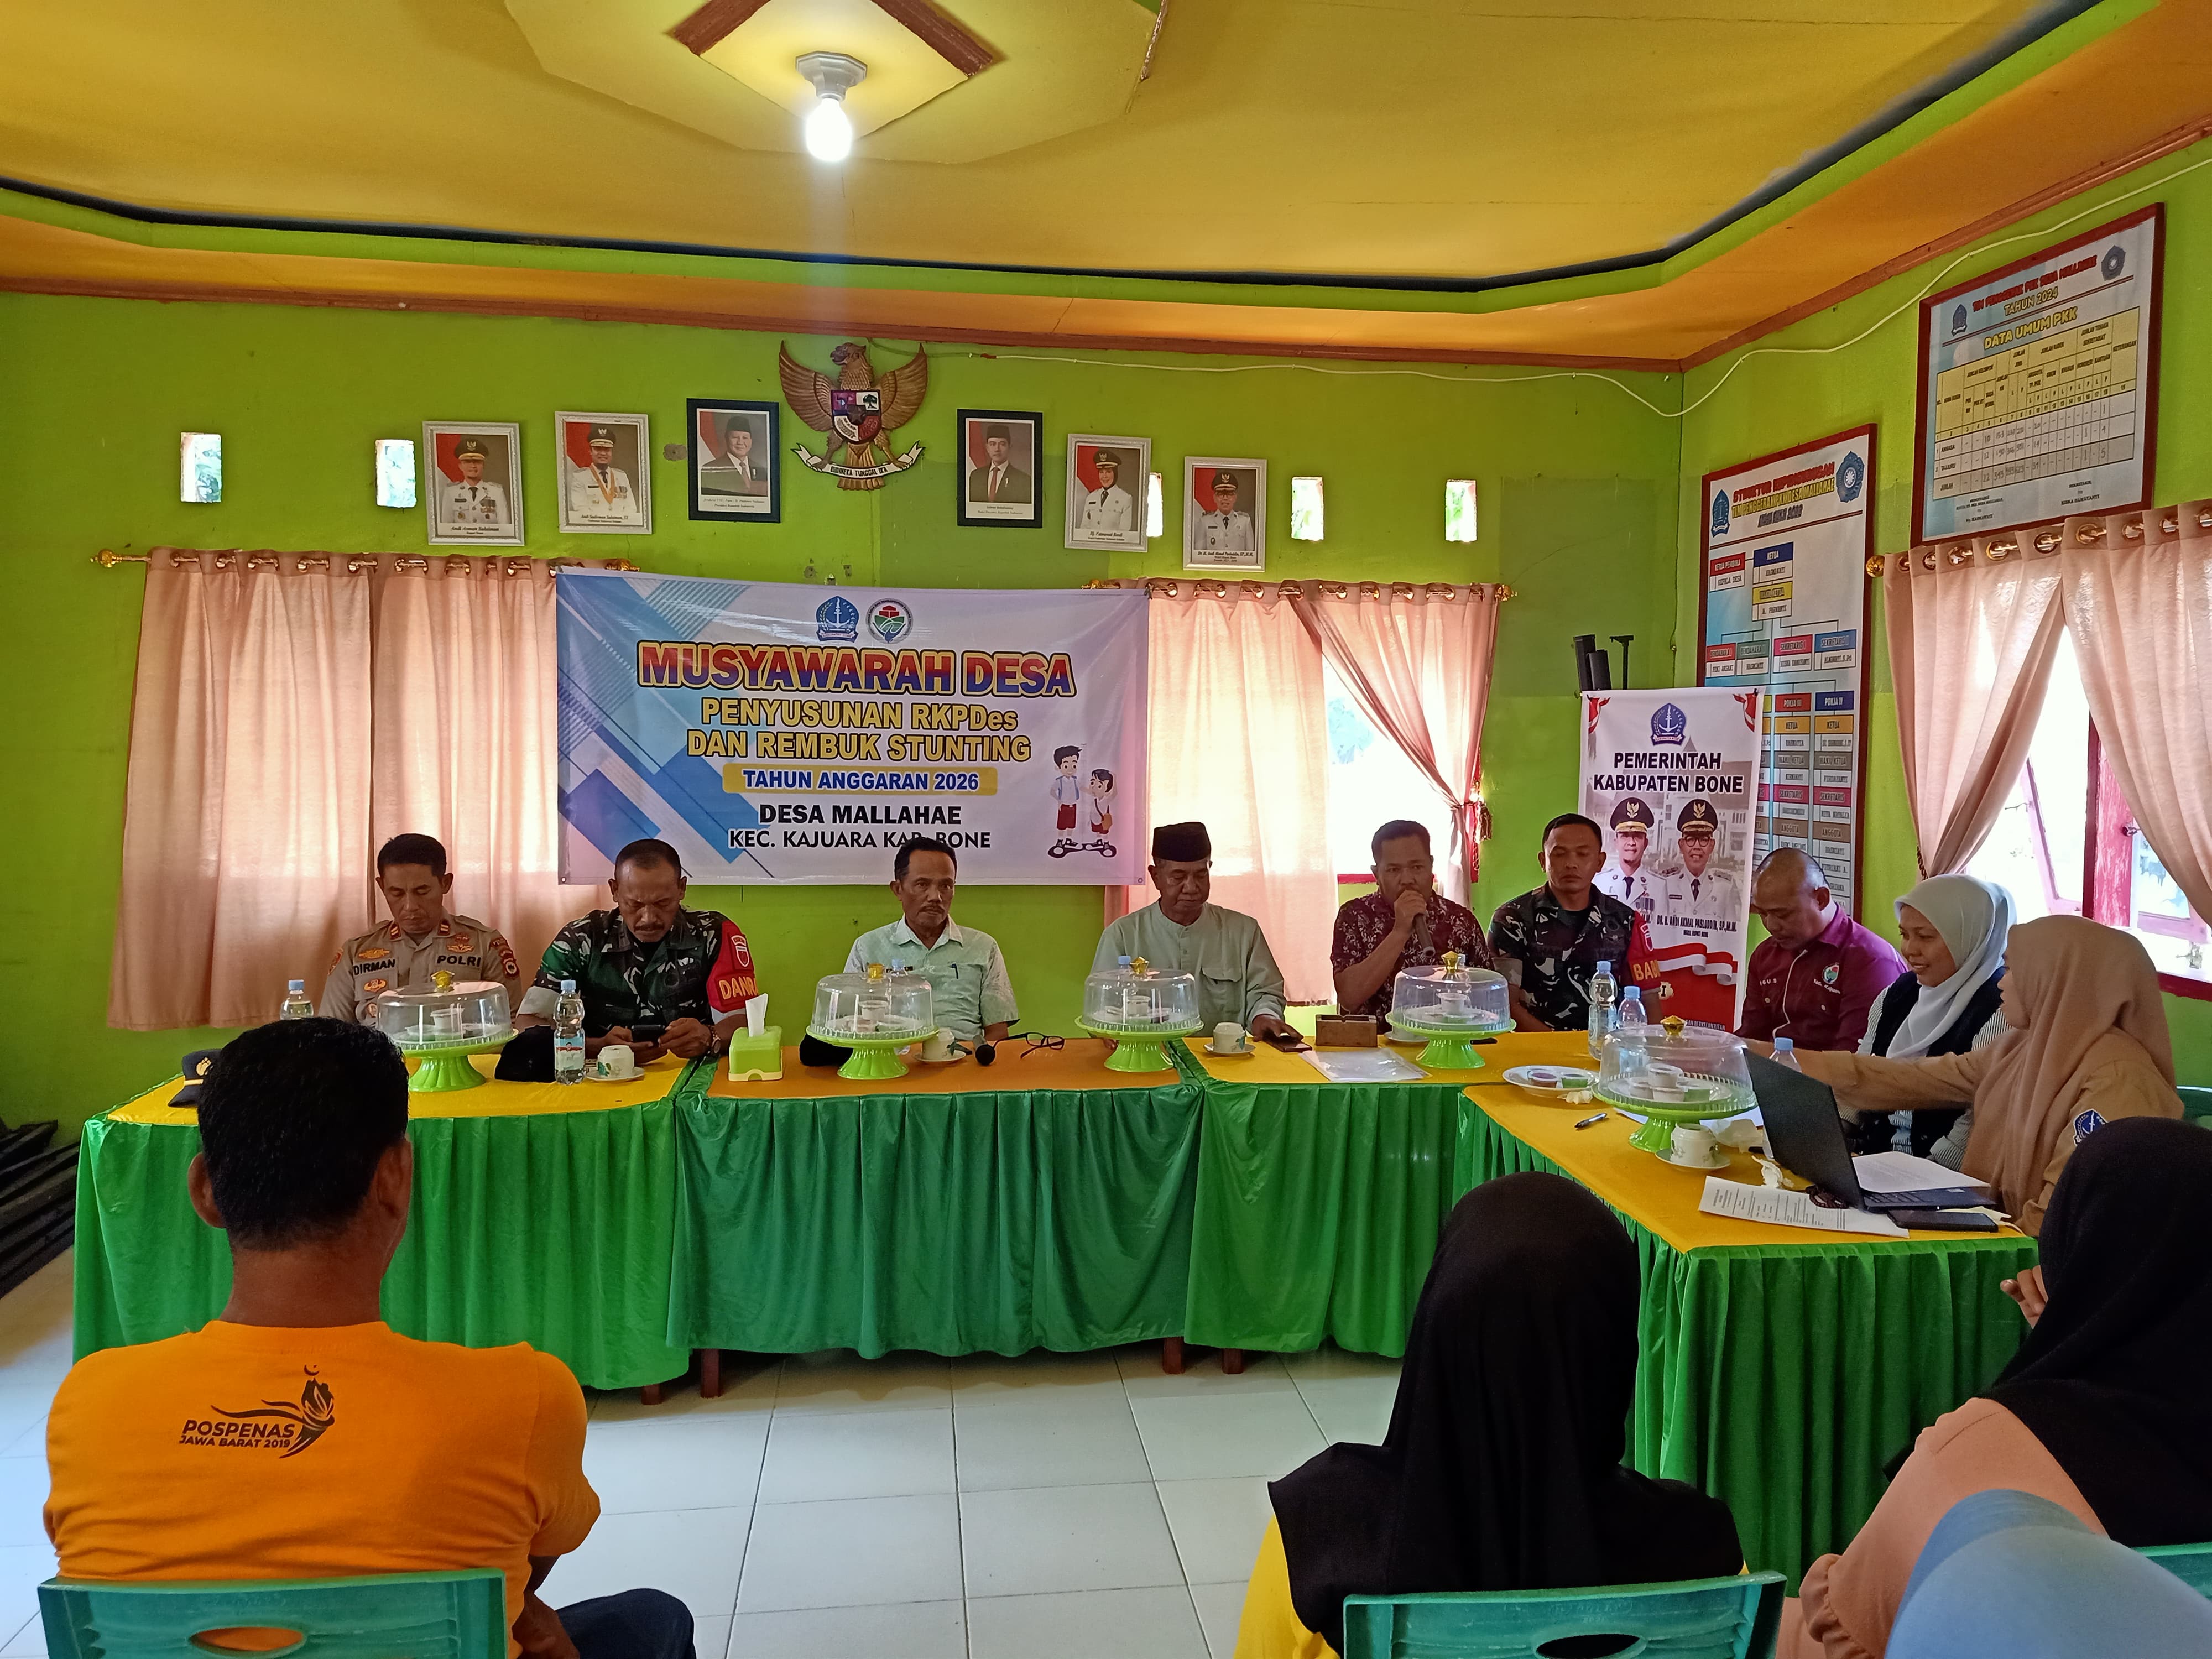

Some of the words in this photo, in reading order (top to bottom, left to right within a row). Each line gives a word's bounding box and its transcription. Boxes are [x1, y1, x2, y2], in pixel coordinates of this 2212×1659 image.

[2004, 295, 2035, 316] TAHUN
[2037, 286, 2059, 304] 2024
[1984, 330, 2013, 350] DATA
[2015, 316, 2051, 340] UMUM
[2052, 306, 2078, 327] PKK
[2101, 448, 2106, 458] 5
[855, 469, 878, 477] TUNGGAL
[1731, 502, 1743, 519] TIM
[1788, 486, 1804, 504] DESA
[1804, 477, 1835, 499] MALLAHAE
[1822, 637, 1845, 648] SEKRETARIS
[638, 640, 956, 696] MUSYAWARAH
[961, 650, 1077, 698] DESA
[1784, 699, 1796, 707] POKJA
[1825, 698, 1838, 706] POKJA
[1838, 697, 1843, 705] IV
[702, 697, 902, 729] PENYUSUNAN
[911, 703, 1018, 731] RKPDes
[1827, 721, 1840, 729] KETUA
[687, 729, 748, 758] DAN
[757, 731, 881, 761] REMBUK
[887, 734, 1031, 762] STUNTING
[1614, 752, 1721, 769] PEMERINTAH
[743, 770, 811, 789] TAHUN
[818, 772, 928, 790] ANGGARAN
[934, 773, 978, 790] 2026
[1593, 774, 1689, 792] KABUPATEN
[1695, 776, 1744, 793] BONE
[1779, 790, 1803, 799] SEKRETARIS
[1820, 792, 1845, 802] SEKRETARIS
[760, 804, 825, 824] DESA
[832, 805, 961, 825] MALLAHAE
[1781, 823, 1799, 833] ANGGOTA
[1822, 828, 1842, 837] ANGGOTA
[730, 830, 775, 848] KEC.
[784, 831, 877, 848] KAJUARA
[936, 832, 990, 848] BONE
[1670, 916, 1679, 927] ANDI
[1680, 917, 1694, 928] AKMAL
[1695, 918, 1718, 932] PASLUDDIN,
[352, 958, 396, 975] DIRMAN
[437, 954, 481, 968] POLRI
[182, 1420, 295, 1438] POSPENAS
[179, 1435, 215, 1446] JAWA
[218, 1438, 262, 1448] BARAT
[263, 1439, 291, 1448] 2019
